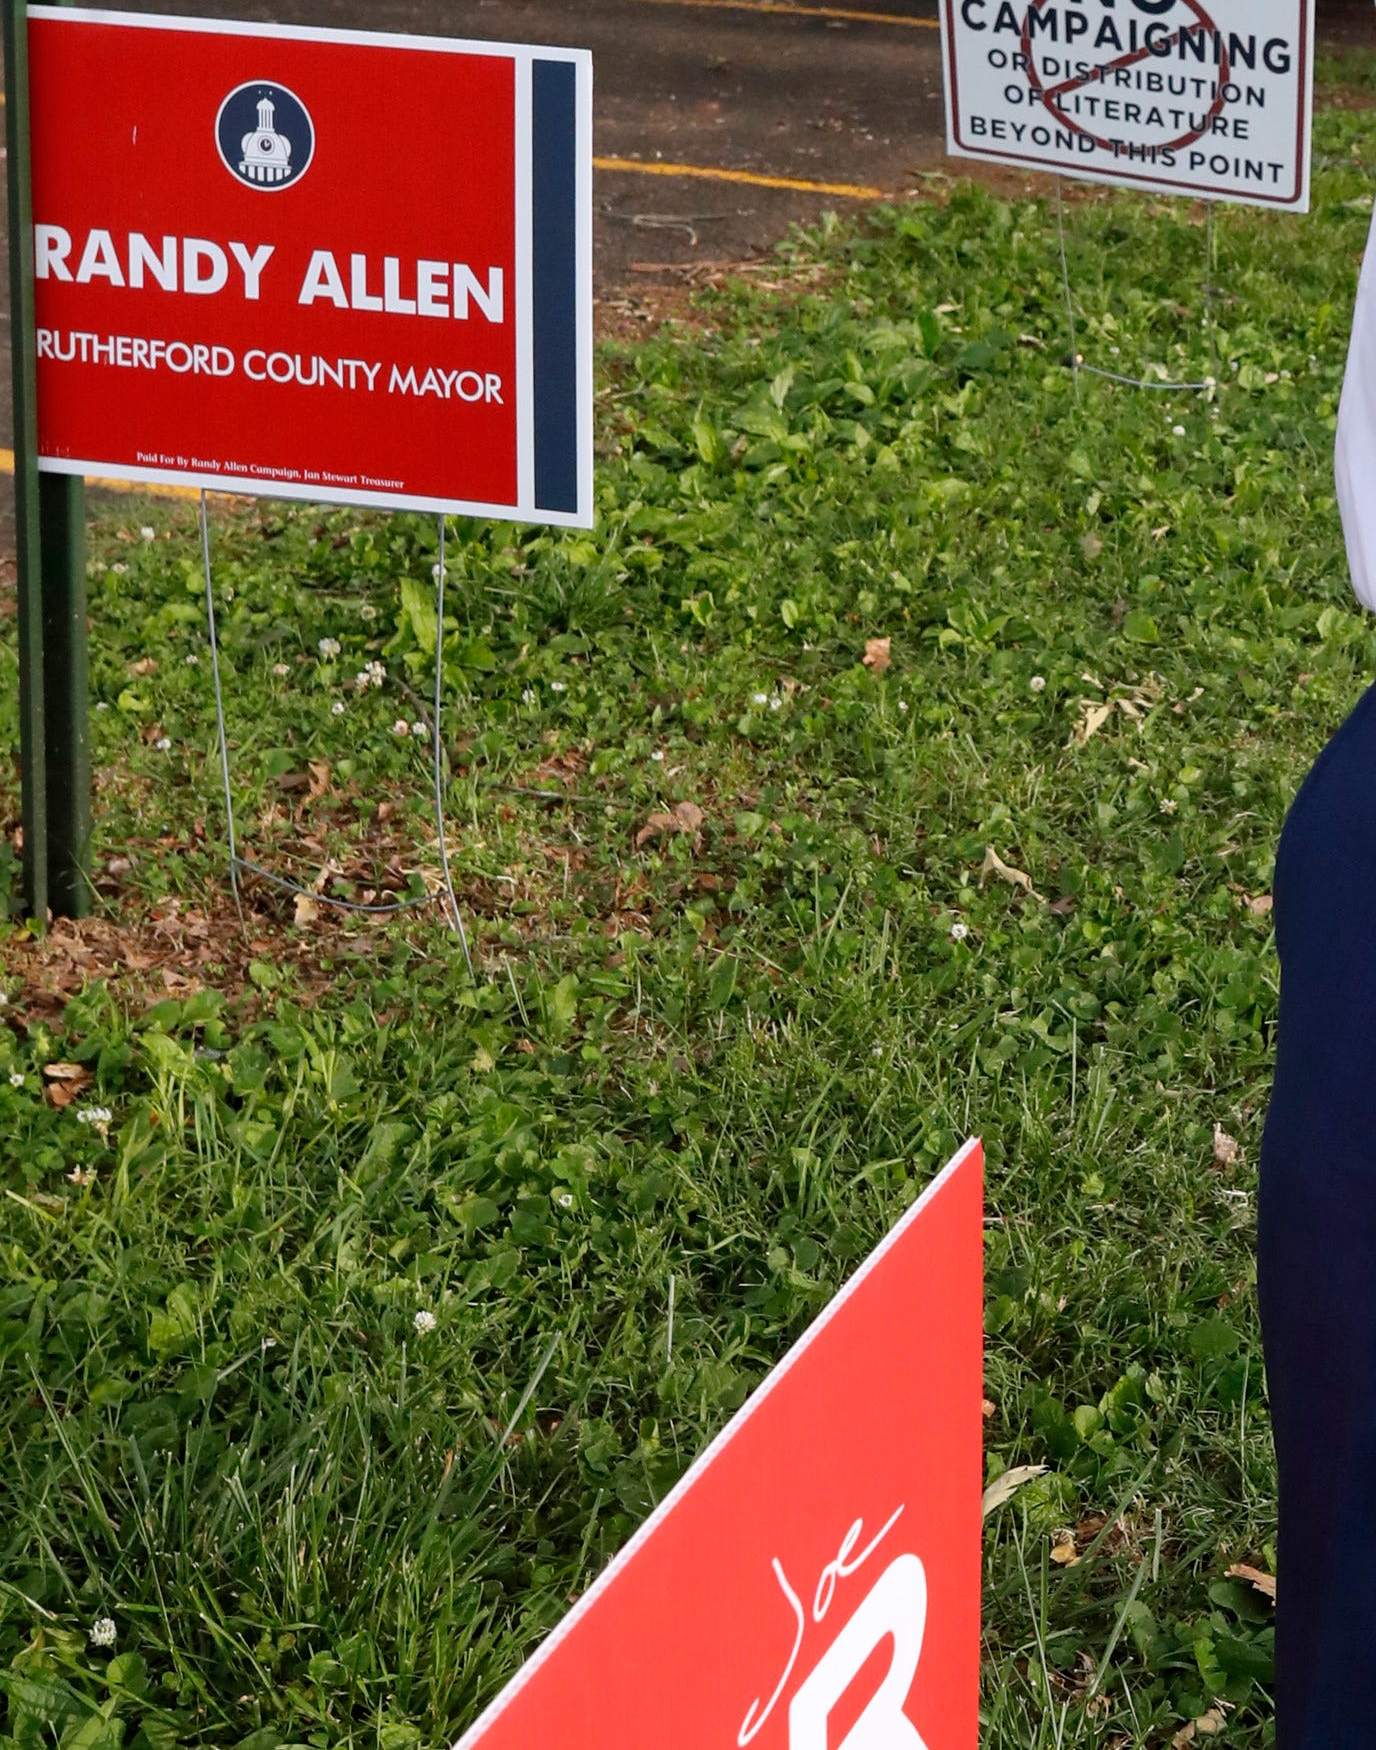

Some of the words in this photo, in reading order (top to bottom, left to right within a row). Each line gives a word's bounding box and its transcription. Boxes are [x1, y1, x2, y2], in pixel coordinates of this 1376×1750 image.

[988, 49, 1029, 72] OR
[1042, 57, 1266, 108] DISTRIBUTION
[1004, 84, 1044, 108] OF
[1057, 92, 1250, 140] LITERATURE
[970, 115, 1097, 153] BEYOND
[1110, 138, 1177, 168] THIS
[1189, 151, 1284, 183] POINT
[34, 223, 275, 300] RANDY
[298, 249, 504, 323] ALLEN
[36, 328, 235, 376] RUTHERFORD
[243, 349, 382, 391] COUNTY
[388, 363, 504, 405] MAYOR
[136, 451, 158, 463] Paid
[160, 454, 175, 464] For
[177, 455, 189, 467] By
[191, 457, 221, 471] Randy
[223, 461, 248, 473] Allen
[250, 464, 302, 479] Campaign,
[303, 469, 320, 481] Jan
[322, 471, 358, 485] Stewart
[360, 475, 405, 489] Treasurer
[737, 1503, 905, 1748] Joe
